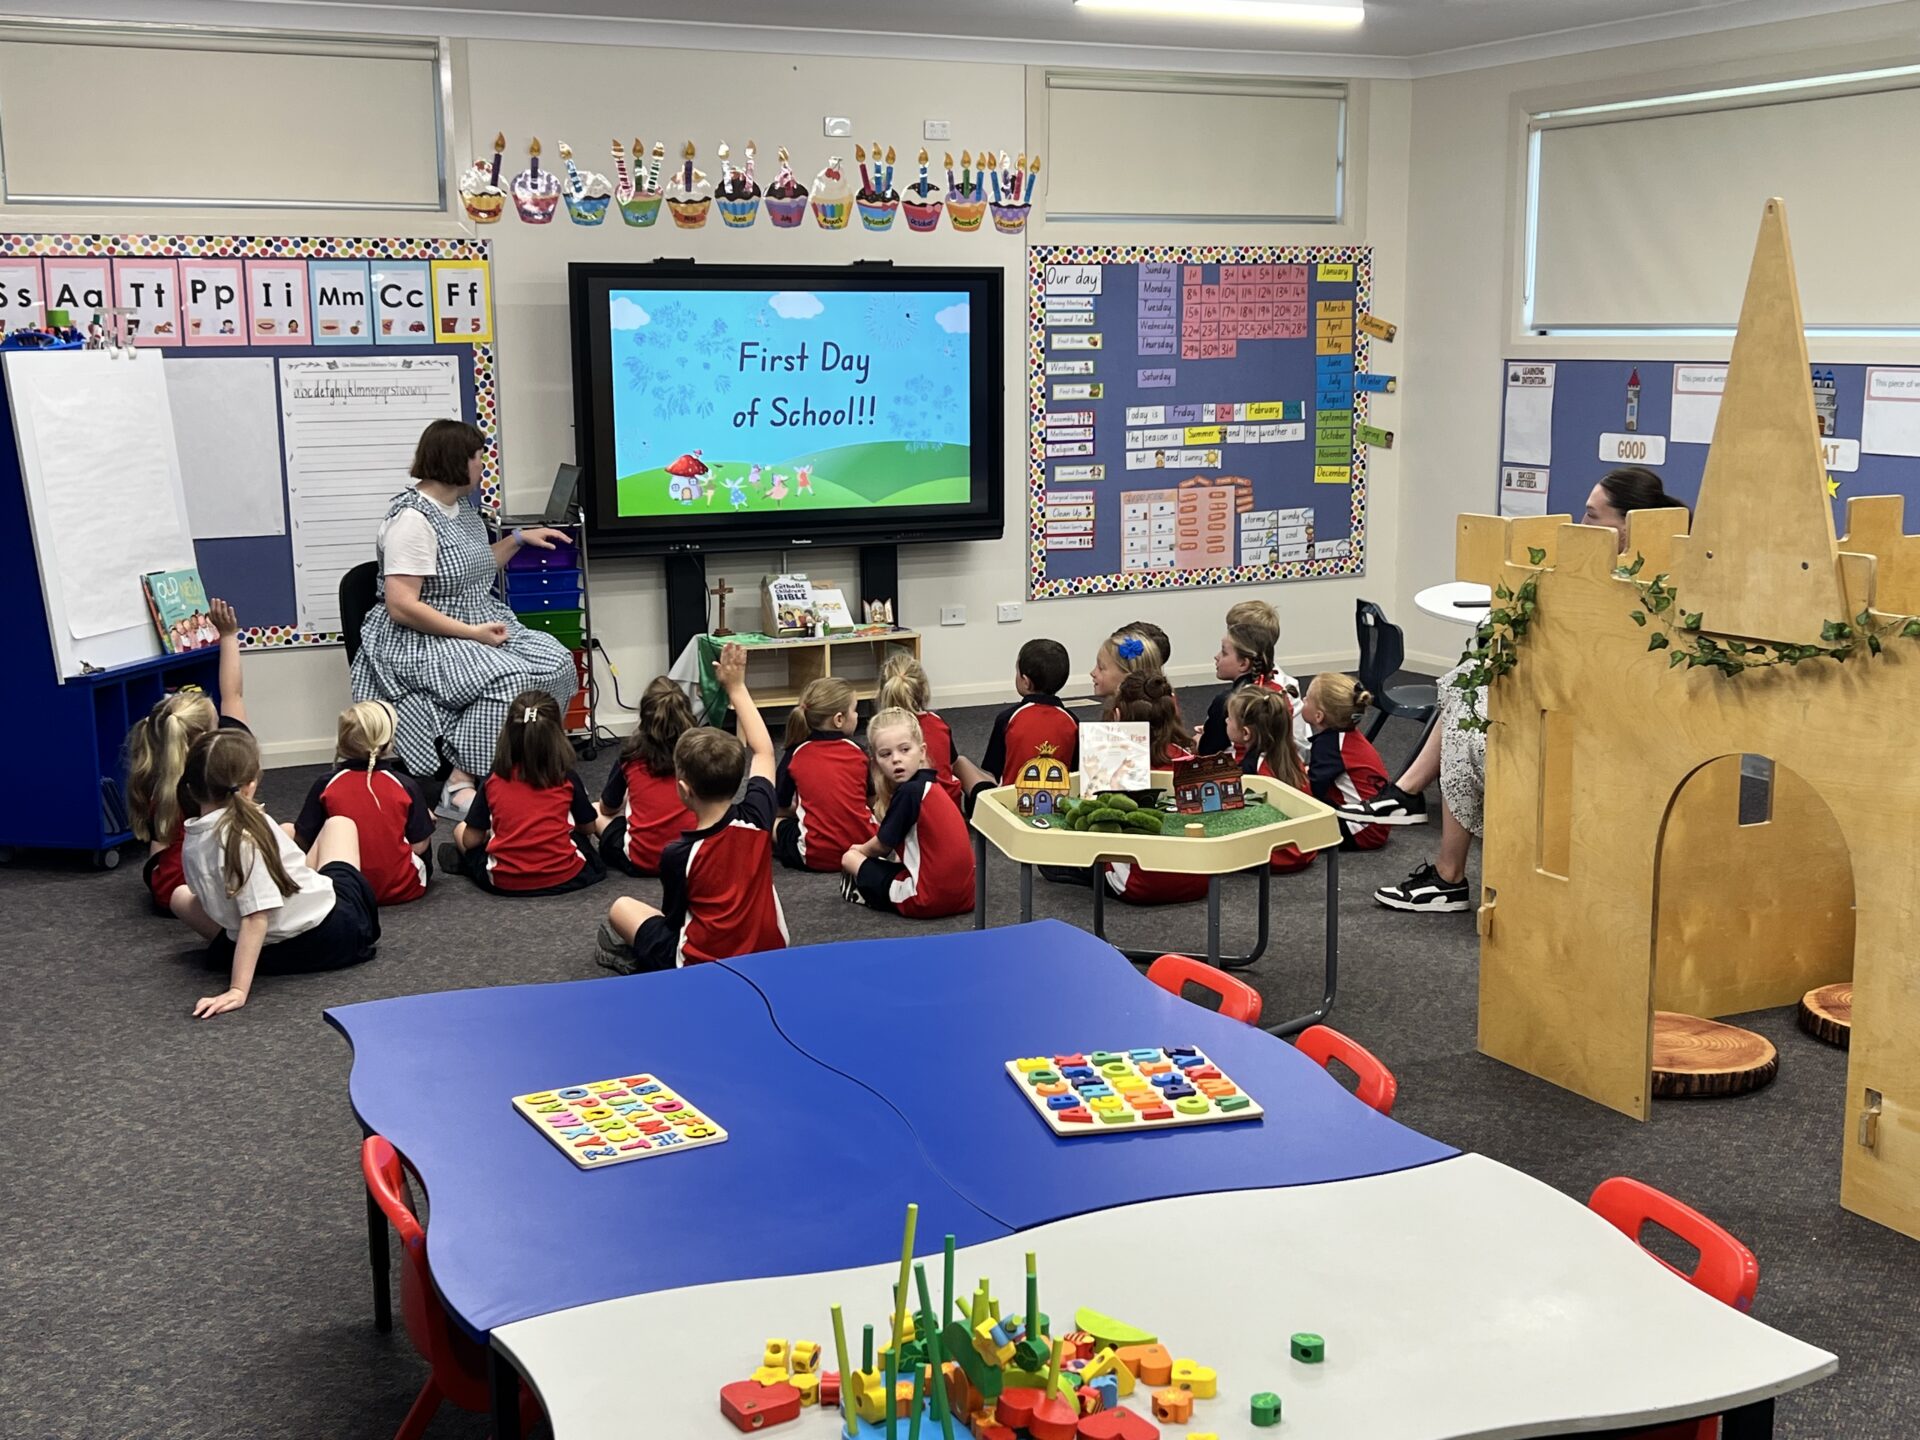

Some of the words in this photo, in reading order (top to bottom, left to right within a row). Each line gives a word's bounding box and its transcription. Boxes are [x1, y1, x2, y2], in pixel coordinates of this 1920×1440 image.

[822, 216, 843, 225] August
[910, 218, 934, 226] October
[1145, 264, 1171, 278] Sunday
[1224, 270, 1234, 280] 3rd
[1259, 269, 1270, 279] 5th
[1277, 268, 1287, 279] 6th
[1322, 265, 1349, 280] January
[1047, 267, 1070, 285] Our
[1075, 267, 1098, 293] day
[1144, 282, 1171, 297] Monday
[1187, 288, 1198, 300] 8th
[1205, 288, 1215, 298] 9th
[1221, 287, 1235, 298] 10th
[1258, 287, 1271, 298] 12th
[1276, 286, 1288, 297] 13th
[1143, 300, 1171, 316] Tuesday
[1185, 306, 1199, 318] 15th
[1204, 306, 1217, 318] 16th
[1222, 306, 1236, 318] 17th
[1241, 305, 1253, 318] 18th
[1258, 305, 1270, 317] 19th
[1323, 302, 1345, 313] March
[1140, 320, 1174, 334] Wednesday
[1326, 320, 1343, 335] April
[1361, 315, 1384, 331] Autumn
[1182, 325, 1199, 338] 22nd
[1202, 326, 1217, 337] 23rd
[1238, 323, 1255, 336] 25th
[1256, 323, 1272, 335] 26th
[1274, 323, 1290, 334] 27th
[1142, 338, 1174, 353] Thursday
[1183, 344, 1199, 357] 29th
[1202, 344, 1218, 355] 30th
[1327, 339, 1342, 353] May
[739, 342, 809, 371] First
[822, 341, 869, 384] Day
[1327, 357, 1342, 367] June
[1050, 364, 1075, 374] Writing
[1522, 367, 1545, 375] LEARNING
[1142, 371, 1171, 384] Saturday
[1328, 374, 1341, 389] July
[1521, 377, 1546, 385] INTENTION
[1875, 379, 1887, 387] This
[1887, 379, 1904, 389] piece
[1905, 379, 1913, 388] of
[1323, 392, 1345, 408] August
[733, 397, 761, 428] of
[770, 395, 875, 427] School!!
[1127, 407, 1148, 424] Today
[1152, 409, 1159, 418] is
[1172, 406, 1196, 420] Friday
[1203, 406, 1214, 417] the
[1219, 407, 1231, 419] 2nd
[1235, 406, 1242, 417] of
[1249, 405, 1280, 418] February
[1049, 415, 1075, 425] Assembly
[1318, 413, 1348, 425] September
[1127, 432, 1139, 443] The
[1144, 433, 1169, 442] season
[1171, 432, 1178, 441] is
[1188, 429, 1215, 438] Summer
[1228, 429, 1240, 437] and
[1246, 428, 1256, 438] the
[1260, 426, 1287, 437] weather
[1291, 427, 1297, 436] is
[1321, 430, 1346, 440] October
[1362, 425, 1380, 442] Spring
[1318, 449, 1348, 458] November
[1617, 440, 1646, 459] GOOD
[1135, 453, 1146, 463] hot
[1165, 452, 1179, 462] and
[1184, 454, 1203, 465] sunny
[1316, 467, 1348, 477] December
[1052, 507, 1070, 517] Clean
[1281, 512, 1300, 523] windy
[1244, 514, 1266, 526] stormy
[1243, 534, 1264, 545] cloudy
[1248, 550, 1261, 560] cold
[1318, 547, 1334, 557] rainy
[776, 593, 807, 601] BIBLE
